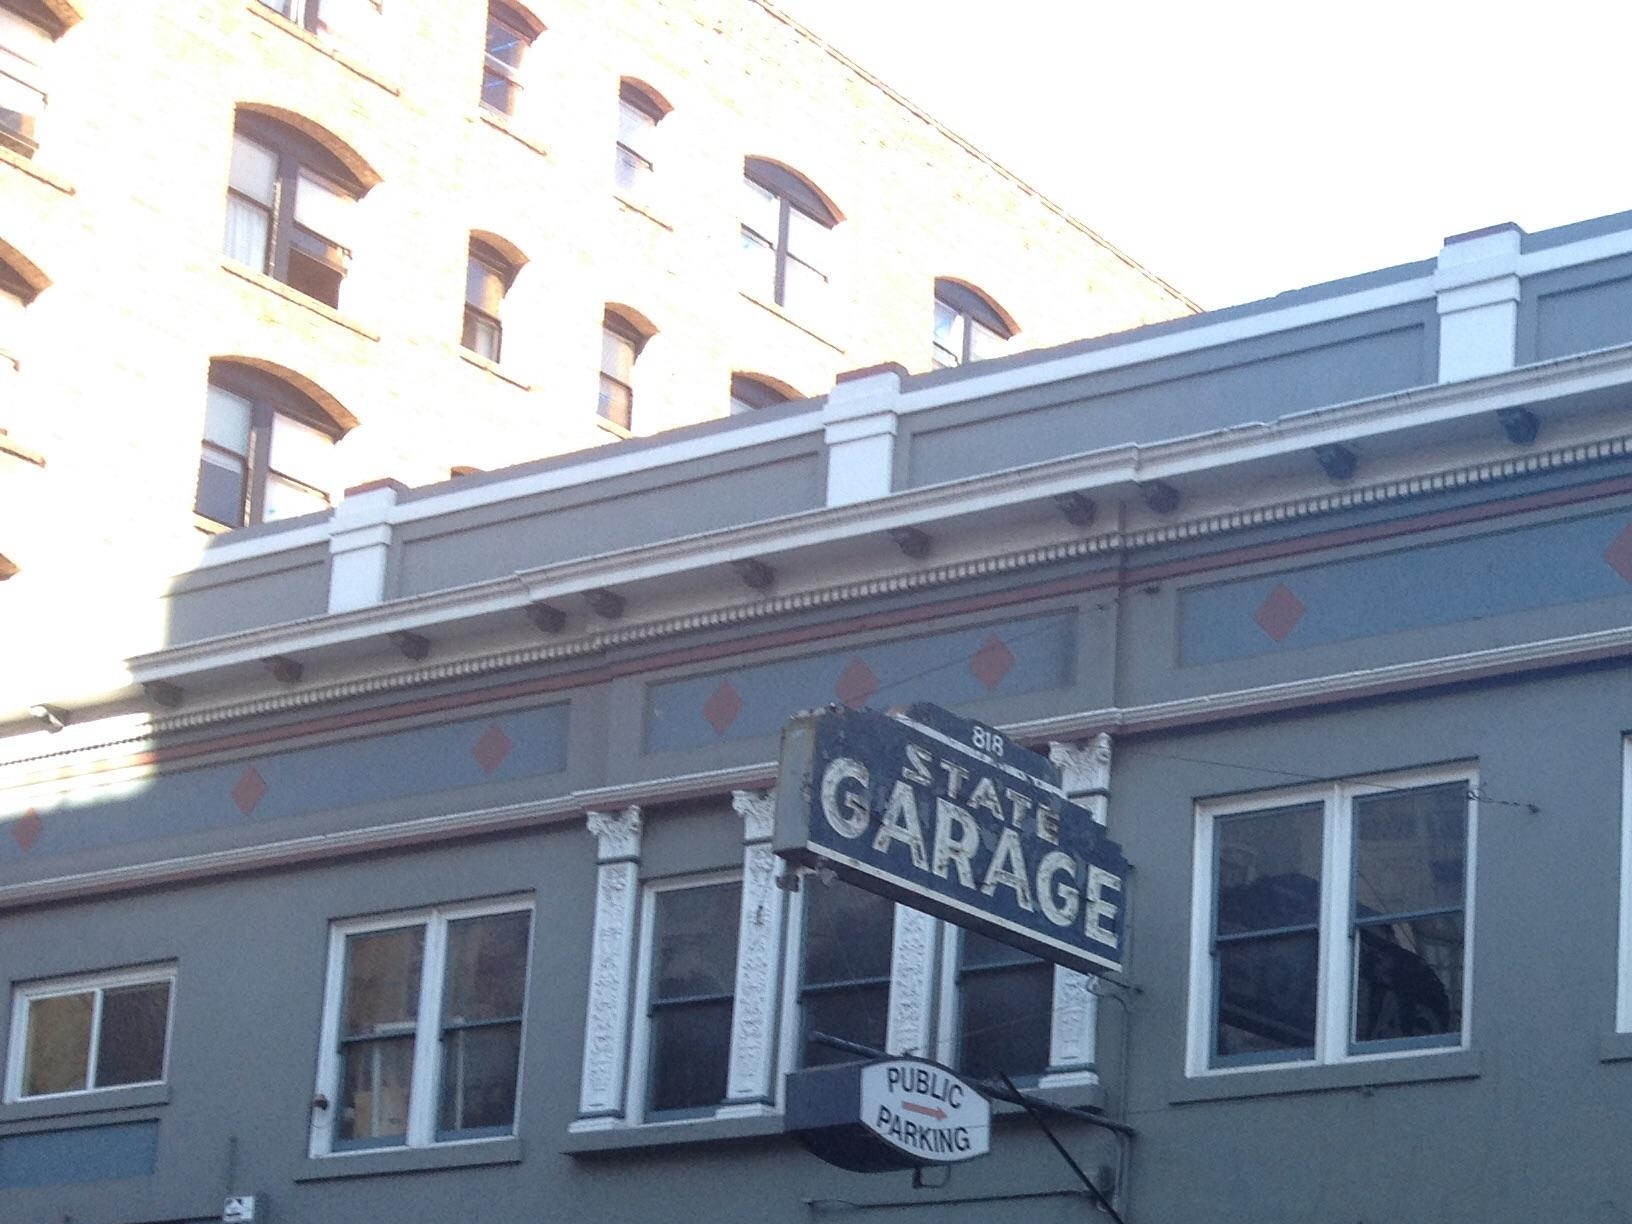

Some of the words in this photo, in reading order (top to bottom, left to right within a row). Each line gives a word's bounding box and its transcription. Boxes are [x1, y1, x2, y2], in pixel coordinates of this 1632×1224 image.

[972, 726, 1004, 757] 818
[902, 743, 1060, 846] STATE
[820, 757, 1123, 949] GARAGE
[887, 1067, 965, 1110] PUBLIC
[877, 1105, 970, 1153] PARKING
